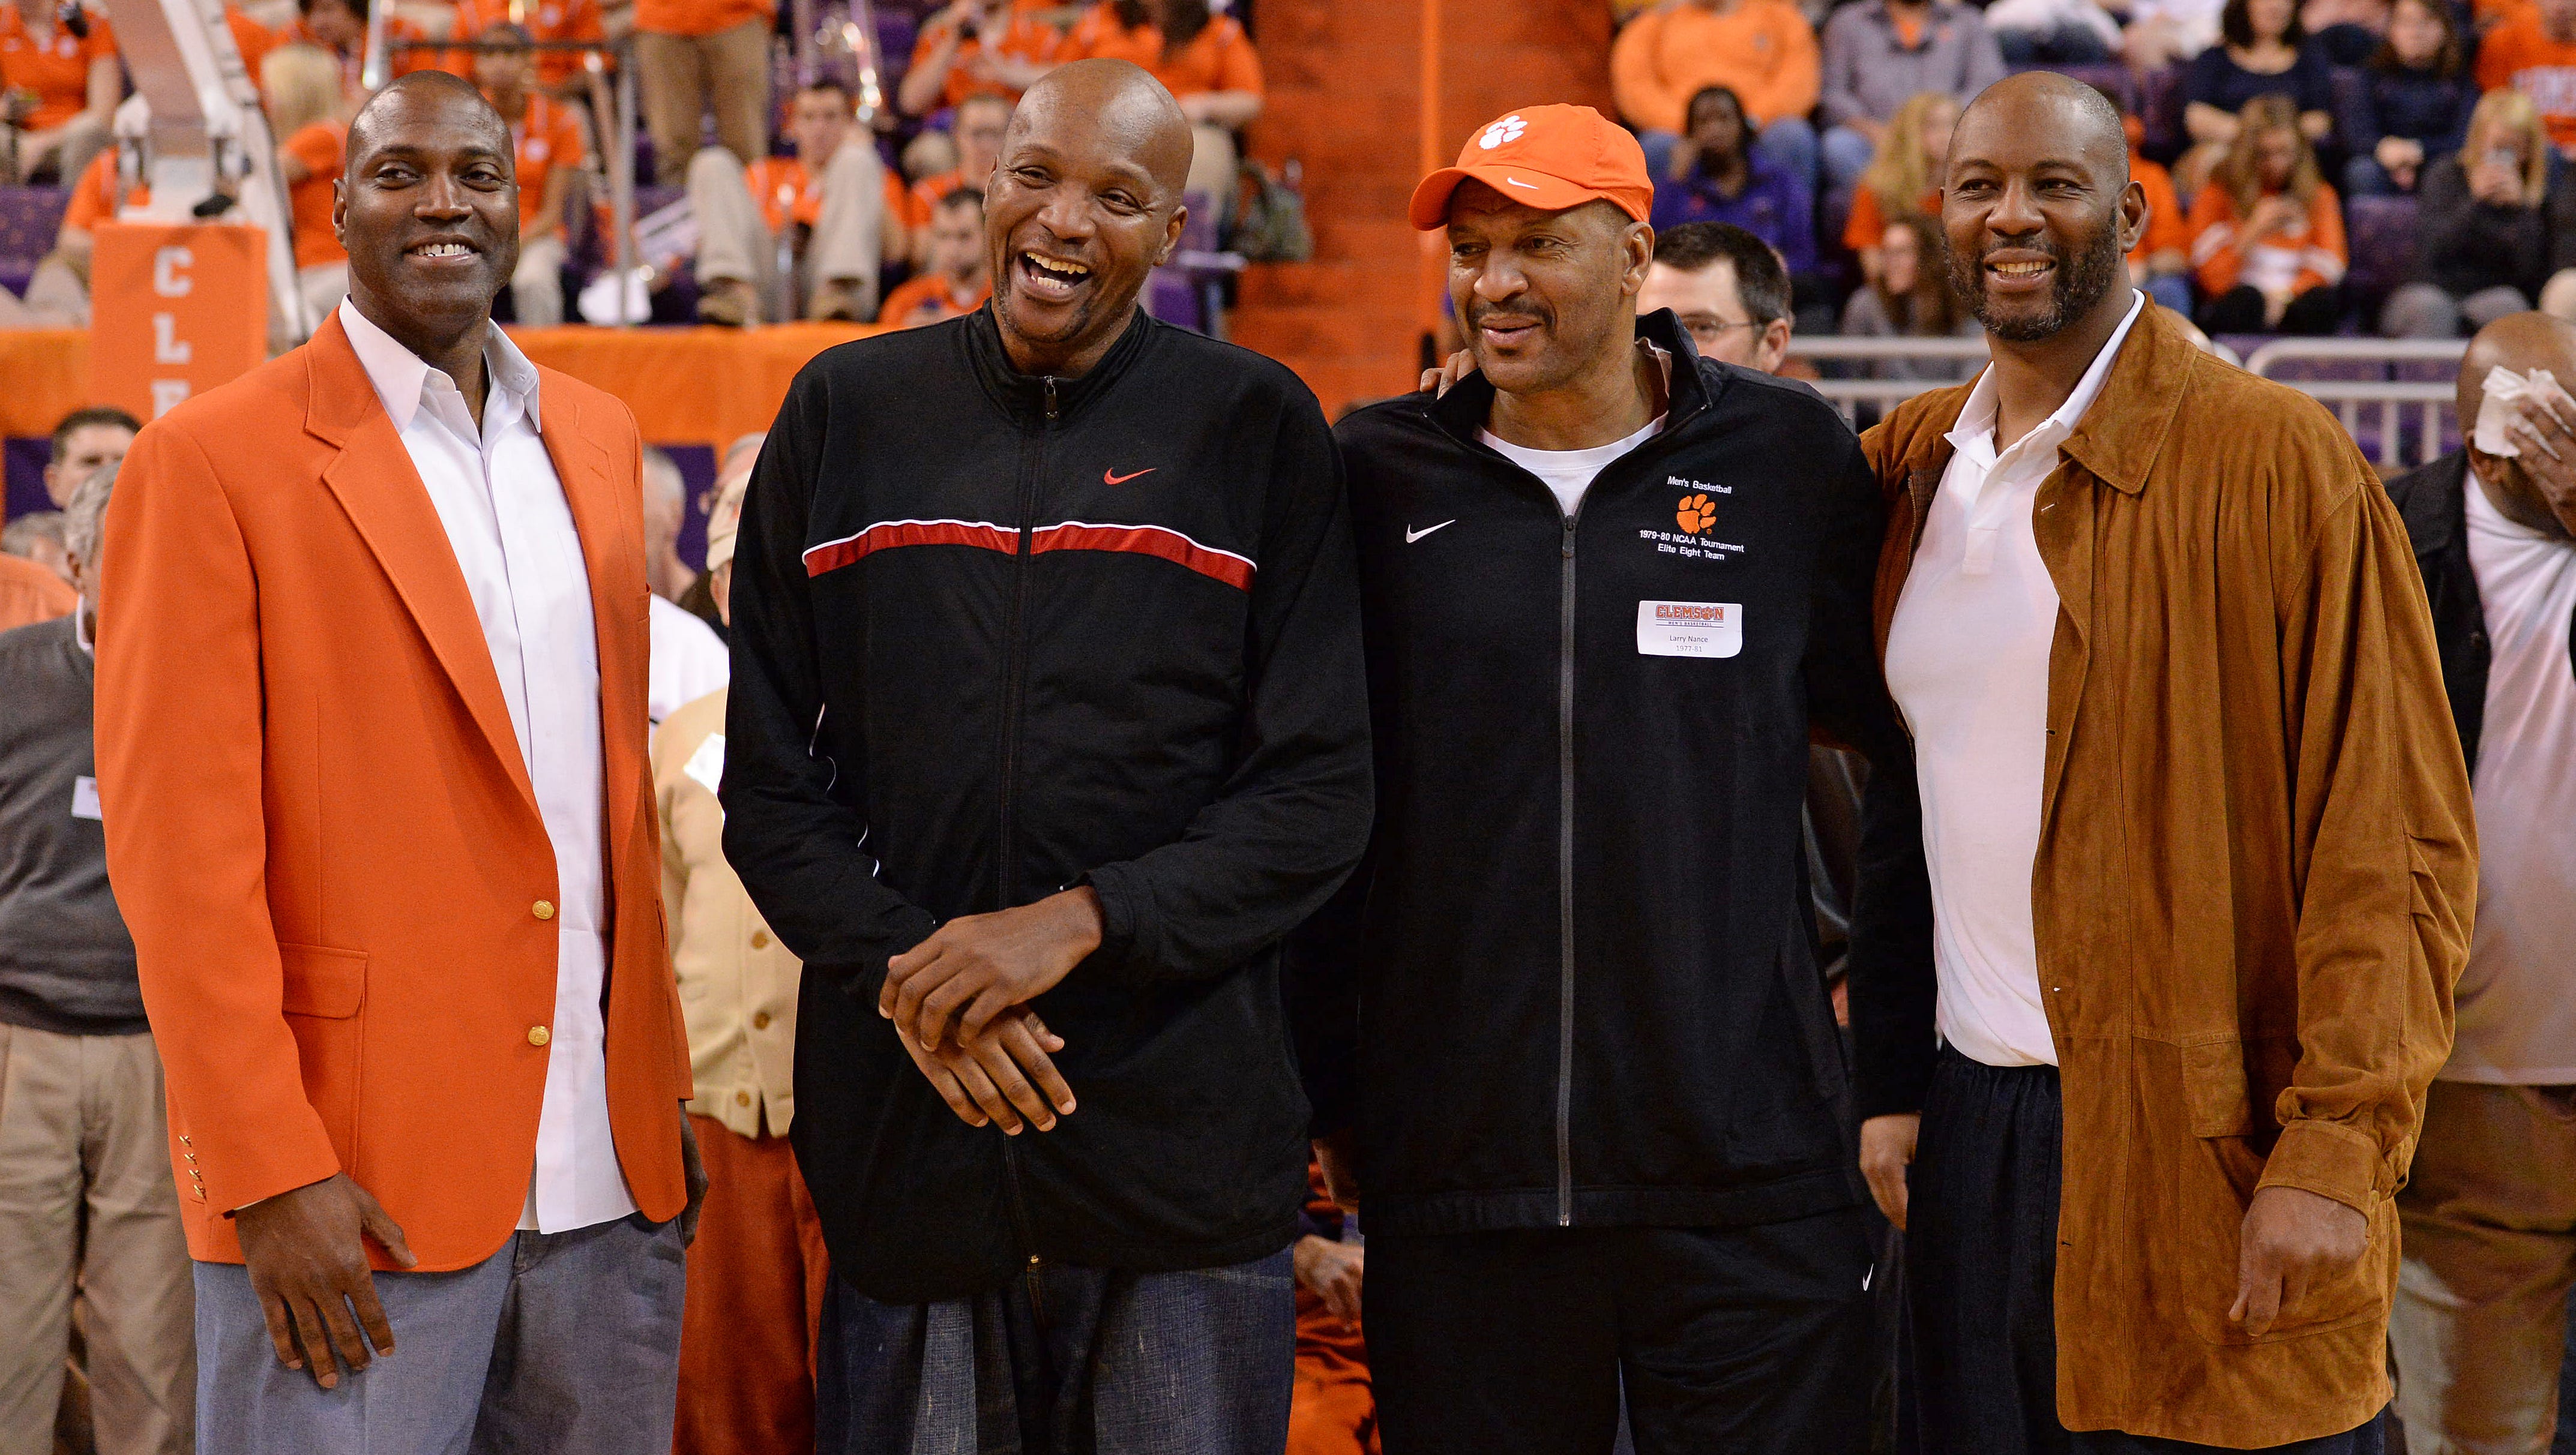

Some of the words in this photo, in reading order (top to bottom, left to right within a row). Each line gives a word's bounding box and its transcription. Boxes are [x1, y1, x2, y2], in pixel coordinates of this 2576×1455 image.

[1667, 475, 1690, 487] Men's
[1693, 480, 1732, 494] Basketball
[1639, 529, 1670, 541] 1979-80
[1672, 533, 1697, 545] NCAA
[1700, 538, 1744, 553] Tournament
[1658, 543, 1676, 553] Elite
[1679, 546, 1701, 557] Eight
[1704, 550, 1725, 560] Team
[1670, 635, 1687, 644] Larry
